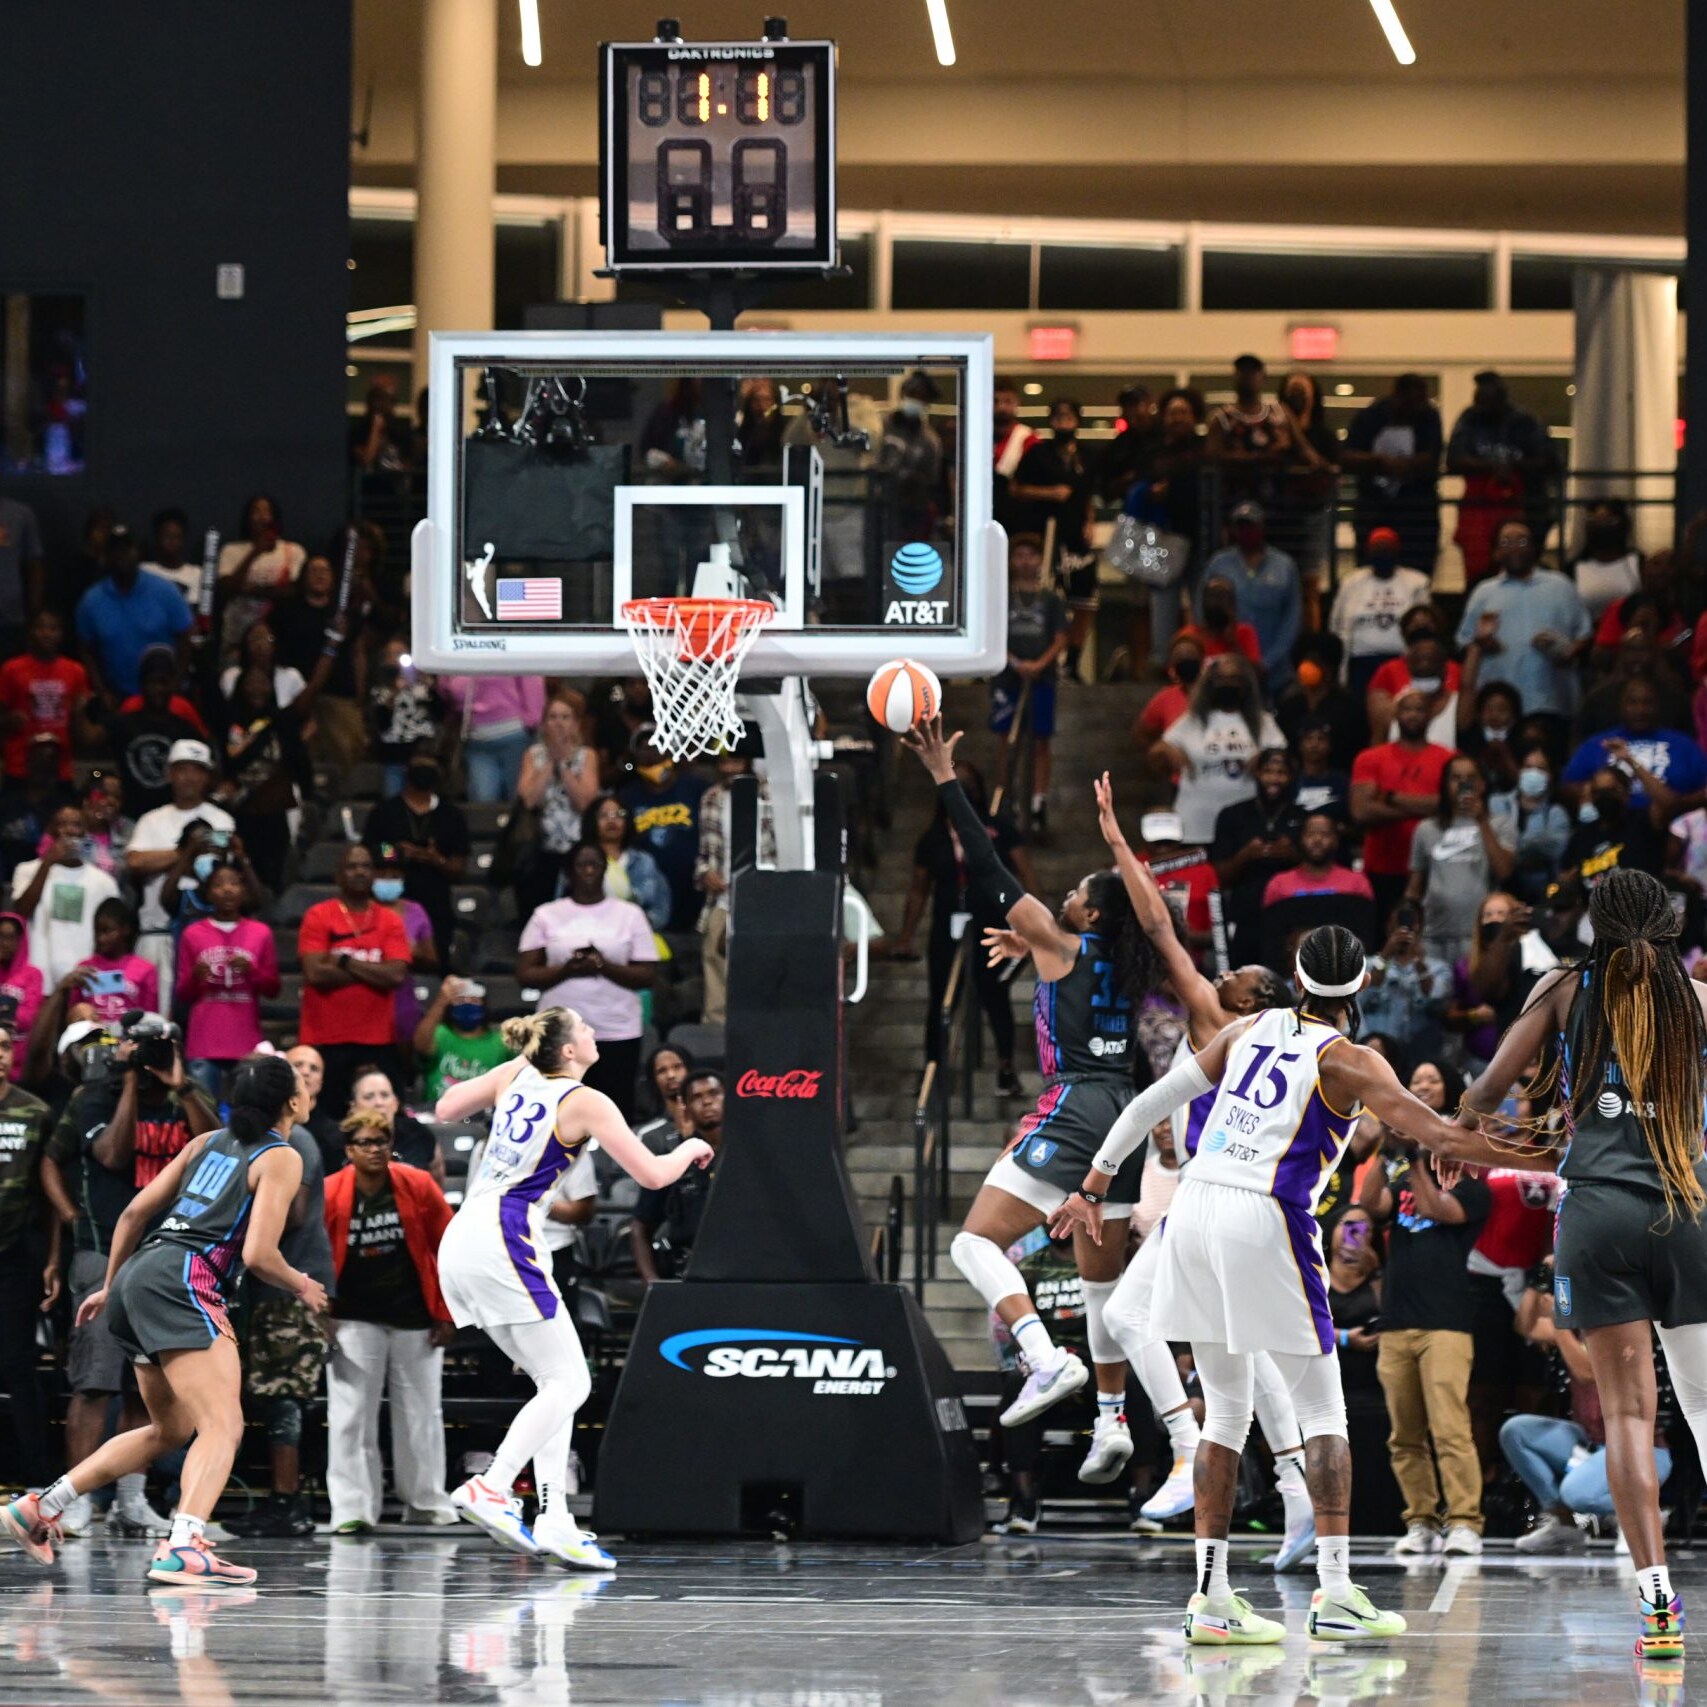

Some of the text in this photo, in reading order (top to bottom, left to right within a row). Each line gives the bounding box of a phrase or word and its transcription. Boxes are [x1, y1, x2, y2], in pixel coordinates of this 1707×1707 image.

[668, 48, 775, 60] DAKTRONICS
[884, 600, 949, 624] AT&T
[453, 639, 506, 651] SPALDING
[736, 1068, 823, 1098] Coca-Cola
[1227, 1044, 1301, 1109] 15
[495, 1093, 547, 1143] 33
[1225, 1105, 1260, 1135] SYKES
[1223, 1142, 1259, 1161] AT&T
[187, 1151, 240, 1200] 00
[366, 1212, 399, 1229] ARM
[703, 1347, 886, 1378] SCANA
[813, 1380, 886, 1395] ENERGY
